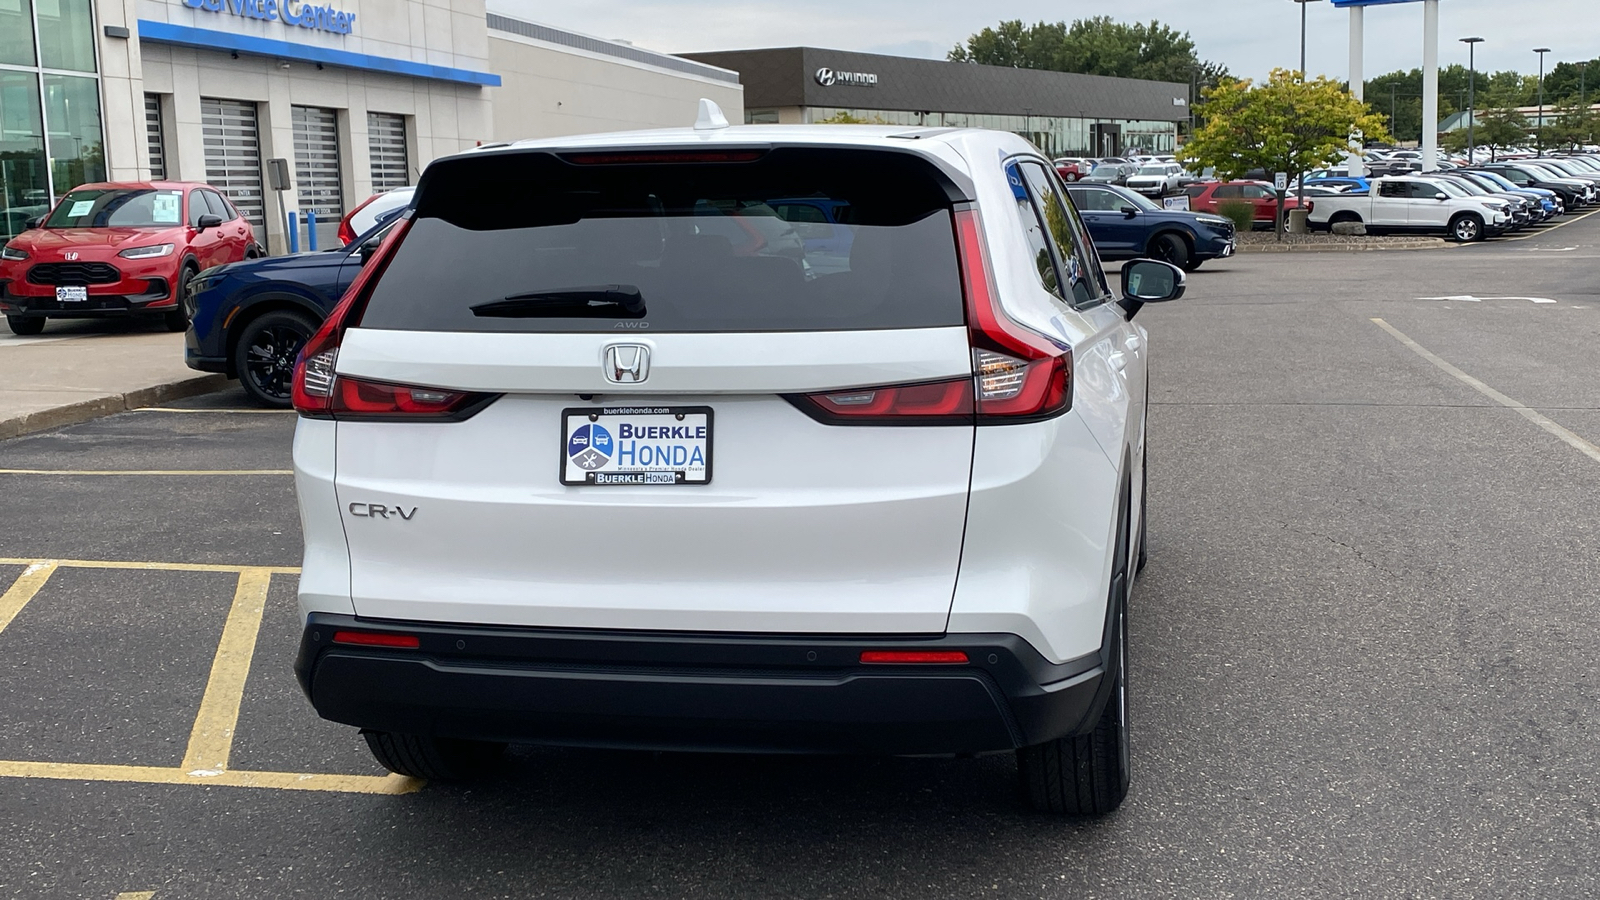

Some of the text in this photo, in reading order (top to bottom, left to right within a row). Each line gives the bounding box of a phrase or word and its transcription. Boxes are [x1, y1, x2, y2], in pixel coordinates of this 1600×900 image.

[182, 0, 356, 34] ervice Center
[836, 71, 878, 84] HYUNDAI
[1277, 181, 1285, 189] 10
[613, 321, 650, 329] AWD
[603, 407, 670, 415] buerklehonda.com
[619, 423, 706, 439] BUERKLE
[618, 440, 705, 466] HONDA
[597, 473, 674, 483] BUERKLE HONDA
[349, 502, 418, 520] CR-V
